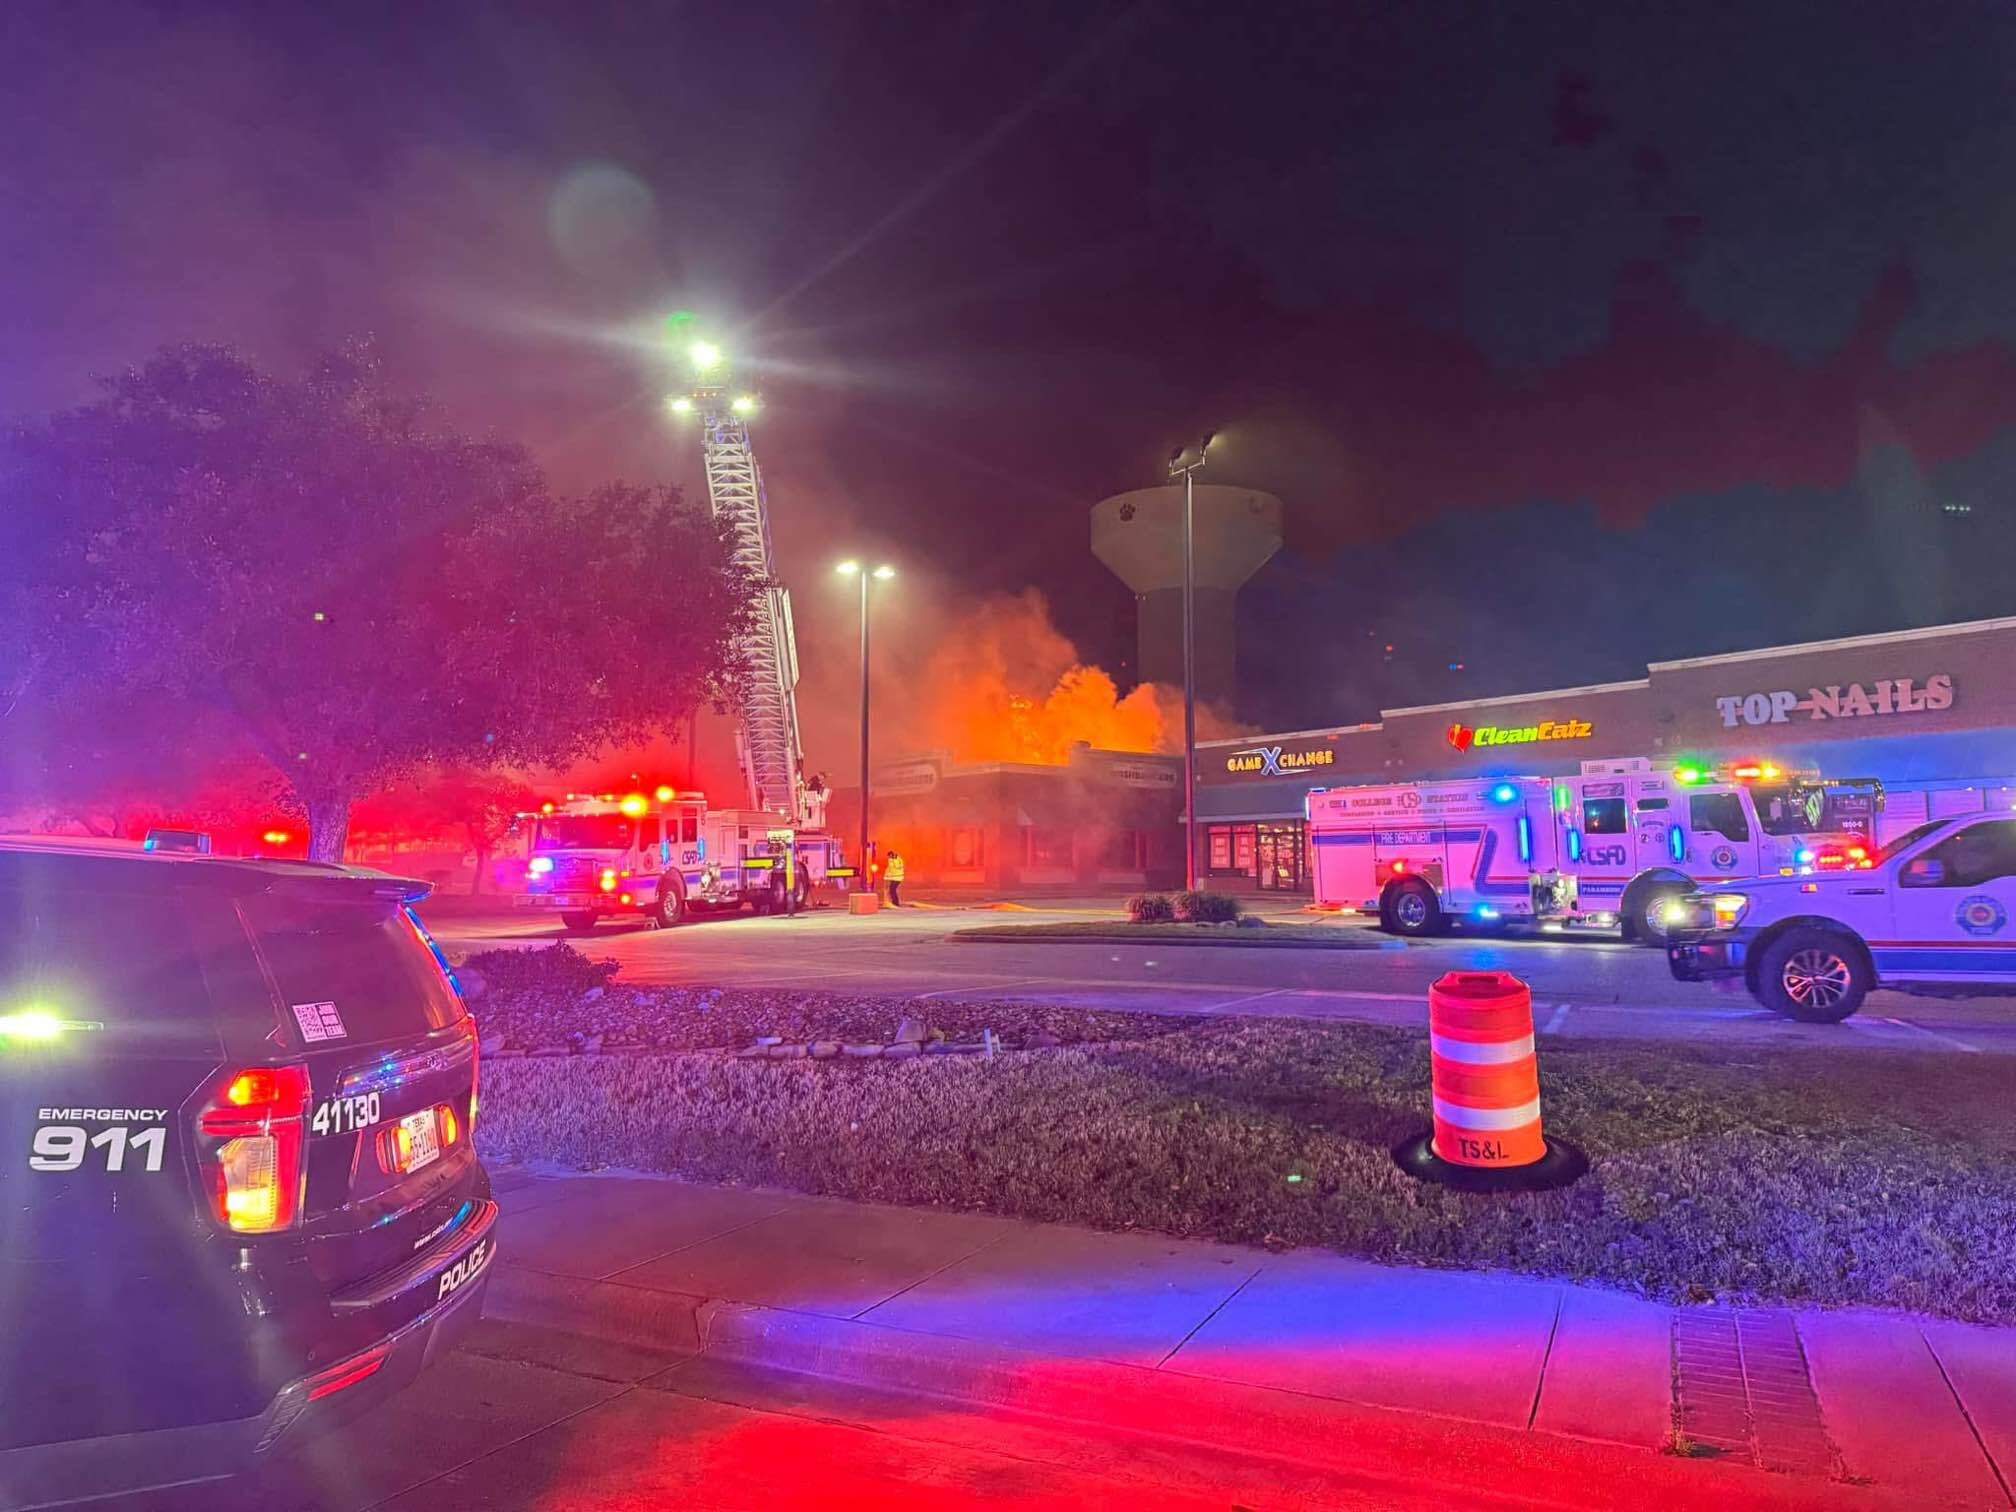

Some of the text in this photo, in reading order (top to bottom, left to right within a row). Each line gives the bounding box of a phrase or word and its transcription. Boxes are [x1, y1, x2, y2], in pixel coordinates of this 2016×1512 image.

[1716, 674, 1953, 728] TOP NAILS
[1473, 719, 1592, 747] CleanEatz
[38, 1108, 168, 1121] EMERGENCY
[312, 1092, 380, 1136] 41130
[29, 1126, 166, 1171] 911
[1459, 1138, 1509, 1160] TS&L
[438, 1239, 486, 1300] POLICE
